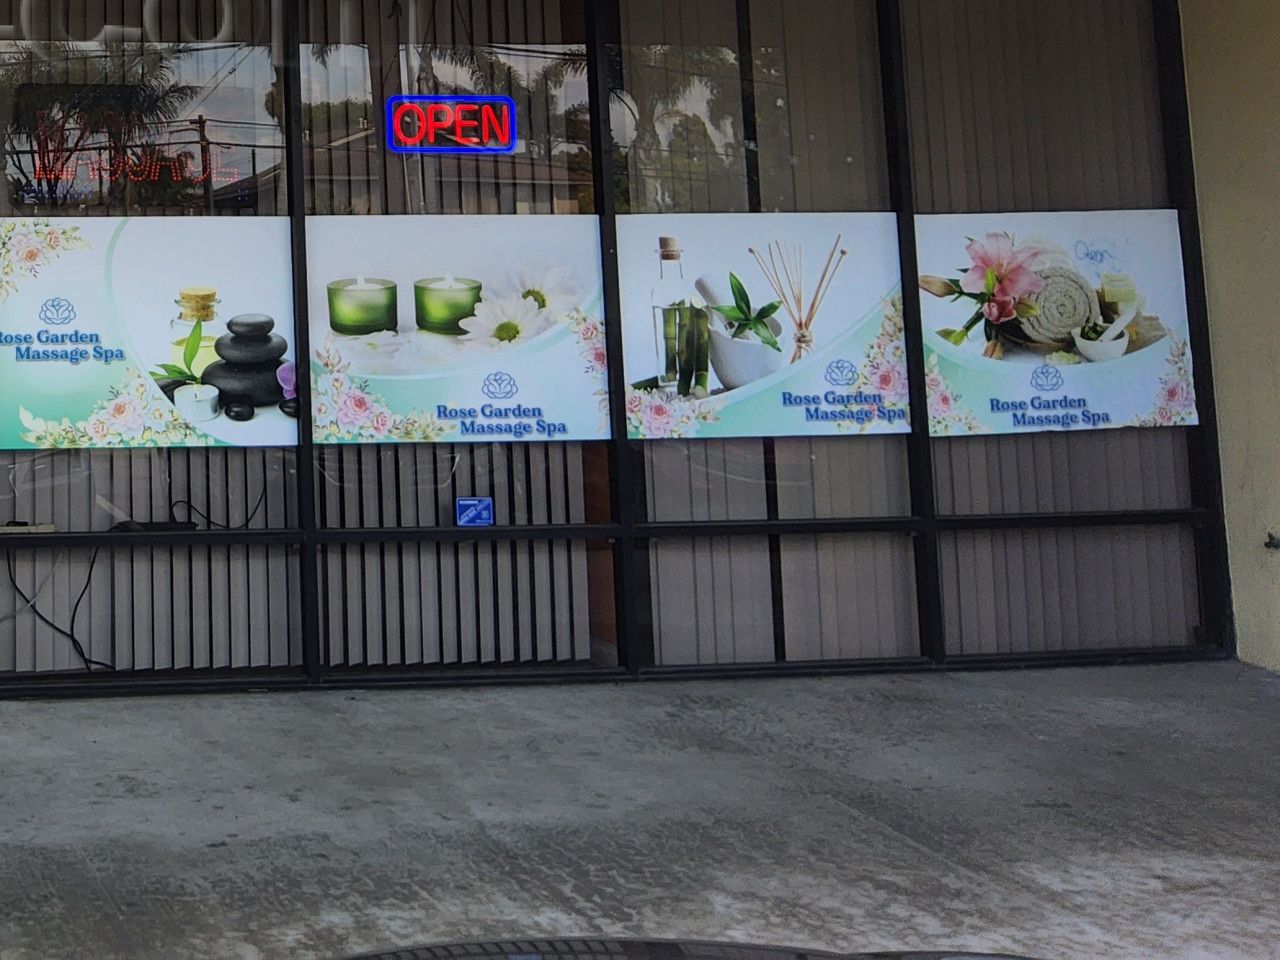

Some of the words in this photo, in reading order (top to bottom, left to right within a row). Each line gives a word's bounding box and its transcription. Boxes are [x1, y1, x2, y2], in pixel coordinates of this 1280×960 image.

[393, 103, 510, 145] OPEN
[36, 329, 101, 344] Garden
[15, 346, 89, 364] Massage
[92, 345, 125, 364] Spa
[782, 391, 822, 406] Rose
[823, 390, 883, 405] Garden
[990, 398, 1028, 412] Rose
[1029, 395, 1088, 410] Garden
[436, 404, 478, 419] Rose
[480, 403, 543, 418] Garden
[804, 406, 874, 424] Massage
[875, 406, 907, 424] Spa
[1012, 412, 1080, 427] Massage
[1081, 409, 1111, 426] Spa
[460, 420, 533, 437] Massage
[535, 419, 567, 437] Spa
